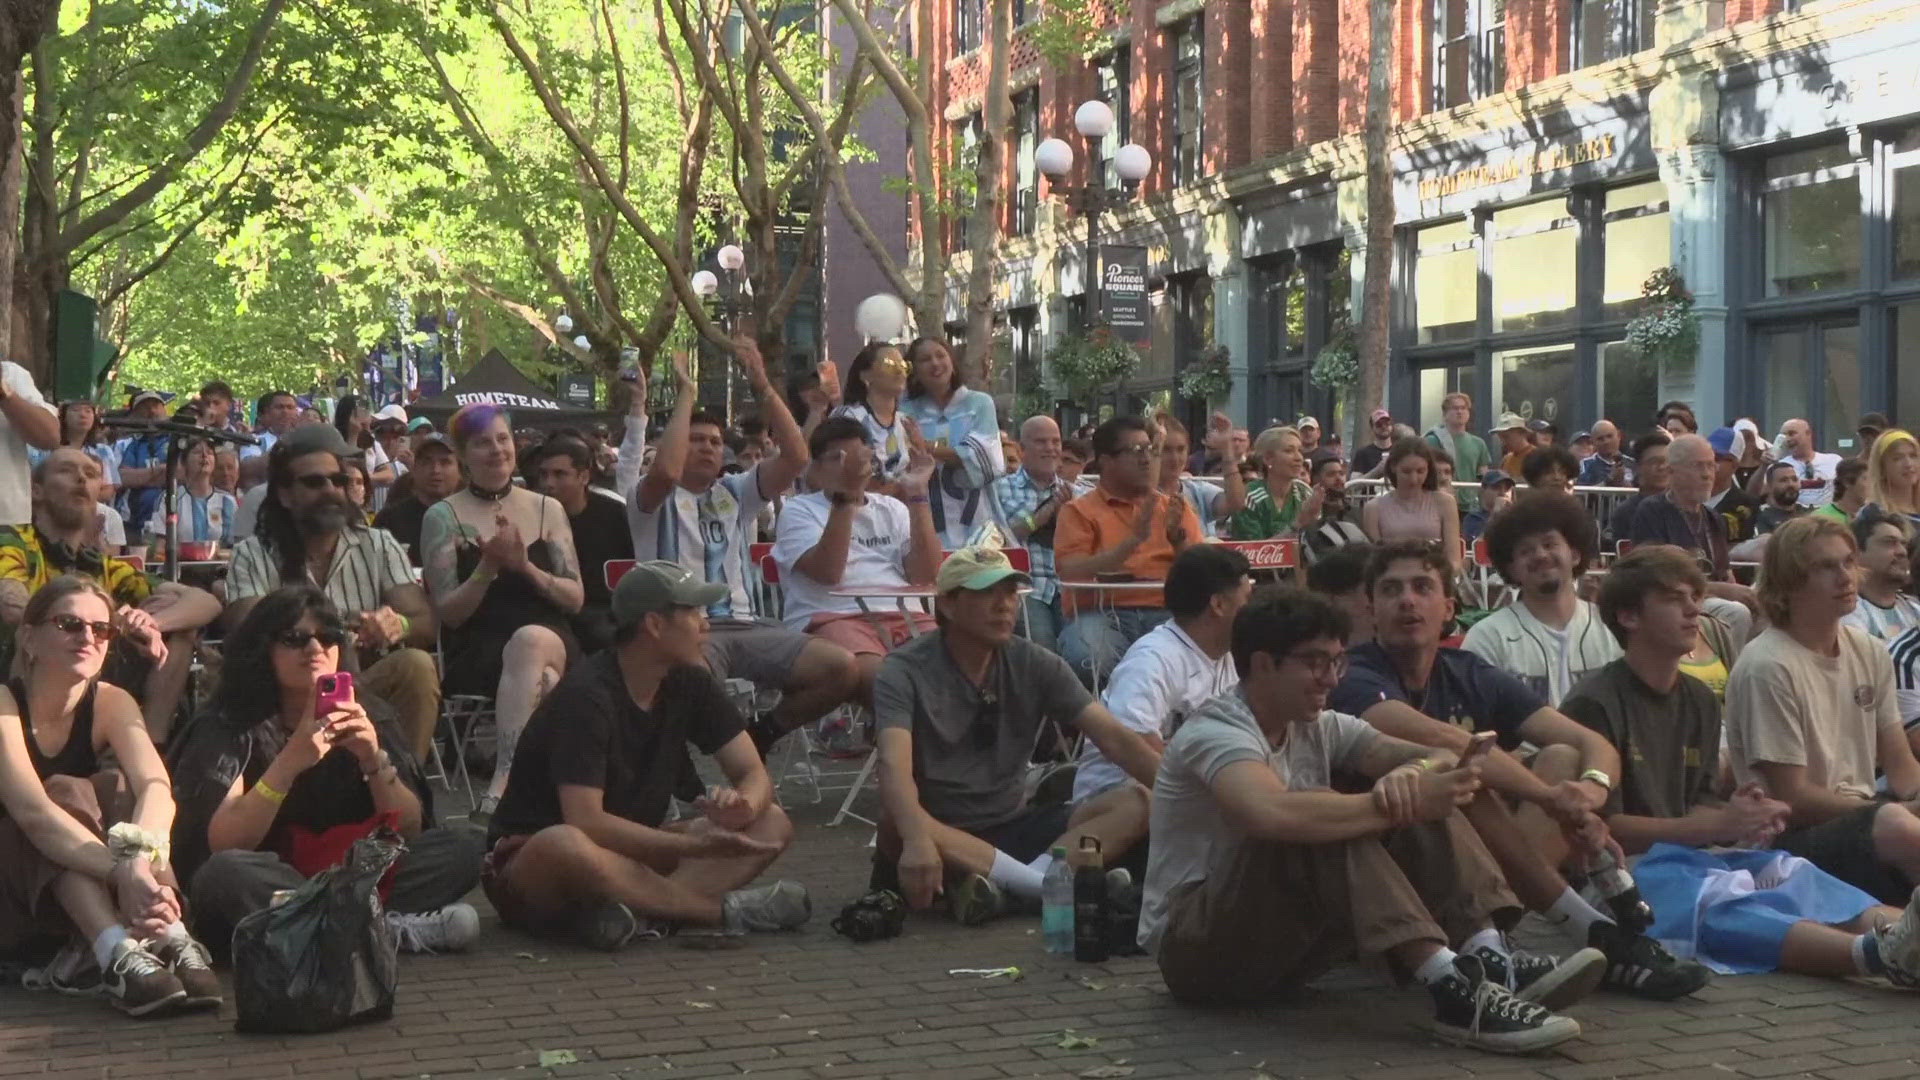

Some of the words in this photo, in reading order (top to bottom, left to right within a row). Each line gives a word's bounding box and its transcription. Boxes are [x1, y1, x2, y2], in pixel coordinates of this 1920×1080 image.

[1820, 64, 1920, 110] CRE
[1419, 158, 1520, 199] HOMETEAM
[1523, 134, 1615, 176] GALLERY
[1106, 263, 1144, 284] Pioneer
[1105, 283, 1145, 292] SQUARE
[455, 391, 561, 410] HOMETEAM
